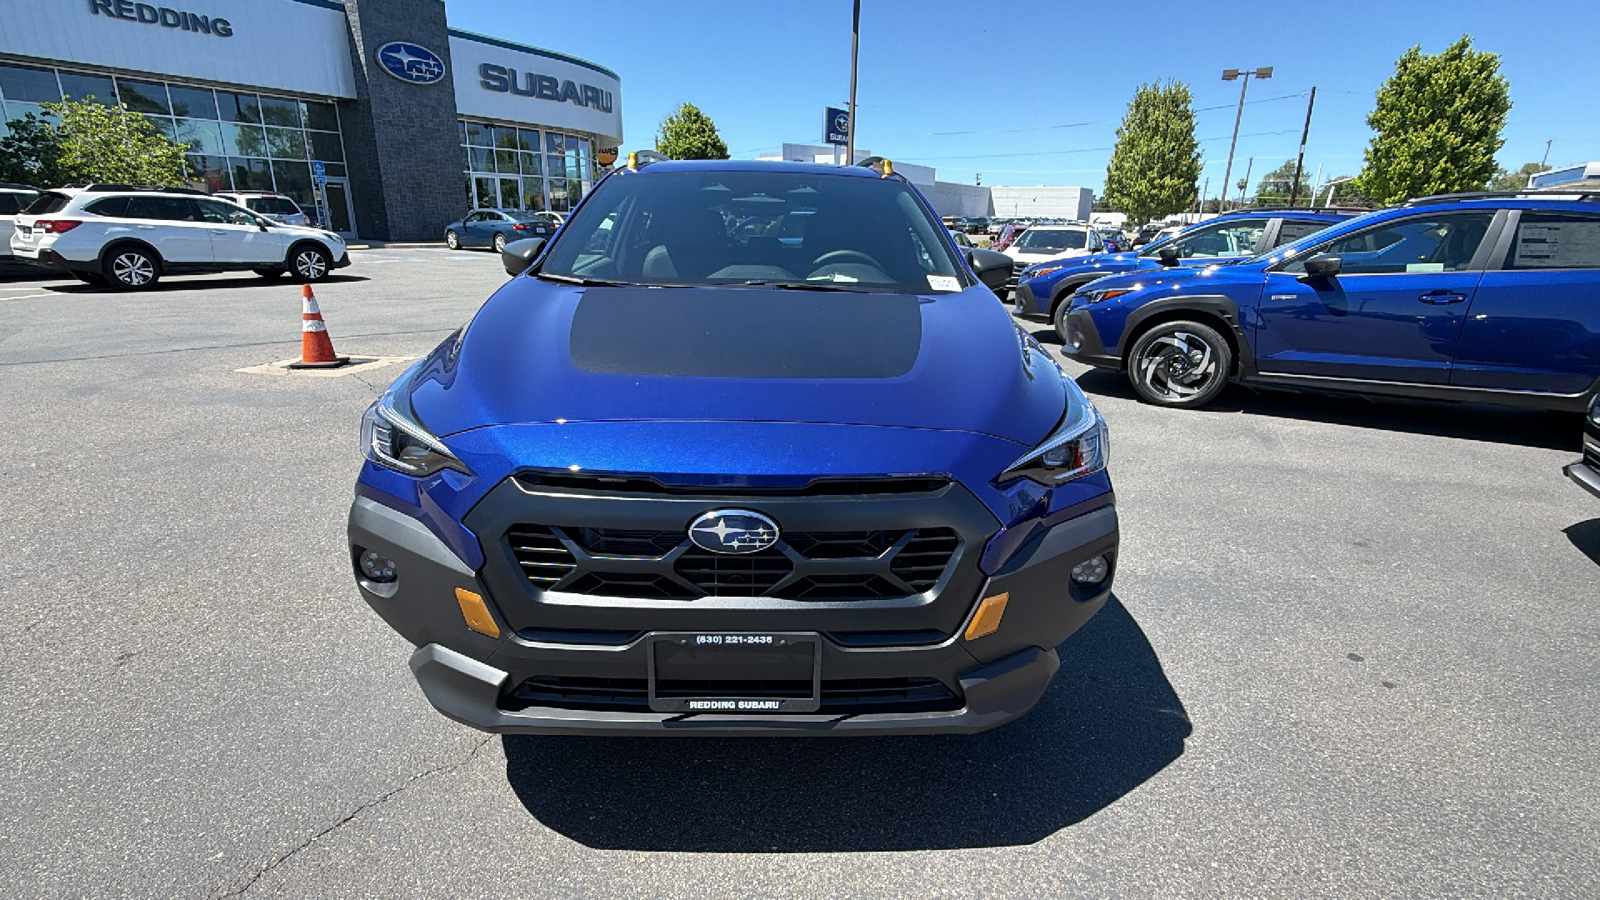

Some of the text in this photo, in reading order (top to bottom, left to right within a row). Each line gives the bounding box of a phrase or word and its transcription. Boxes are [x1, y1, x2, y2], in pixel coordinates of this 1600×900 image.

[89, 0, 233, 37] REDDING
[480, 63, 612, 114] SUBARU
[830, 133, 849, 142] SUBA
[690, 701, 779, 709] REDDING SUBARU
